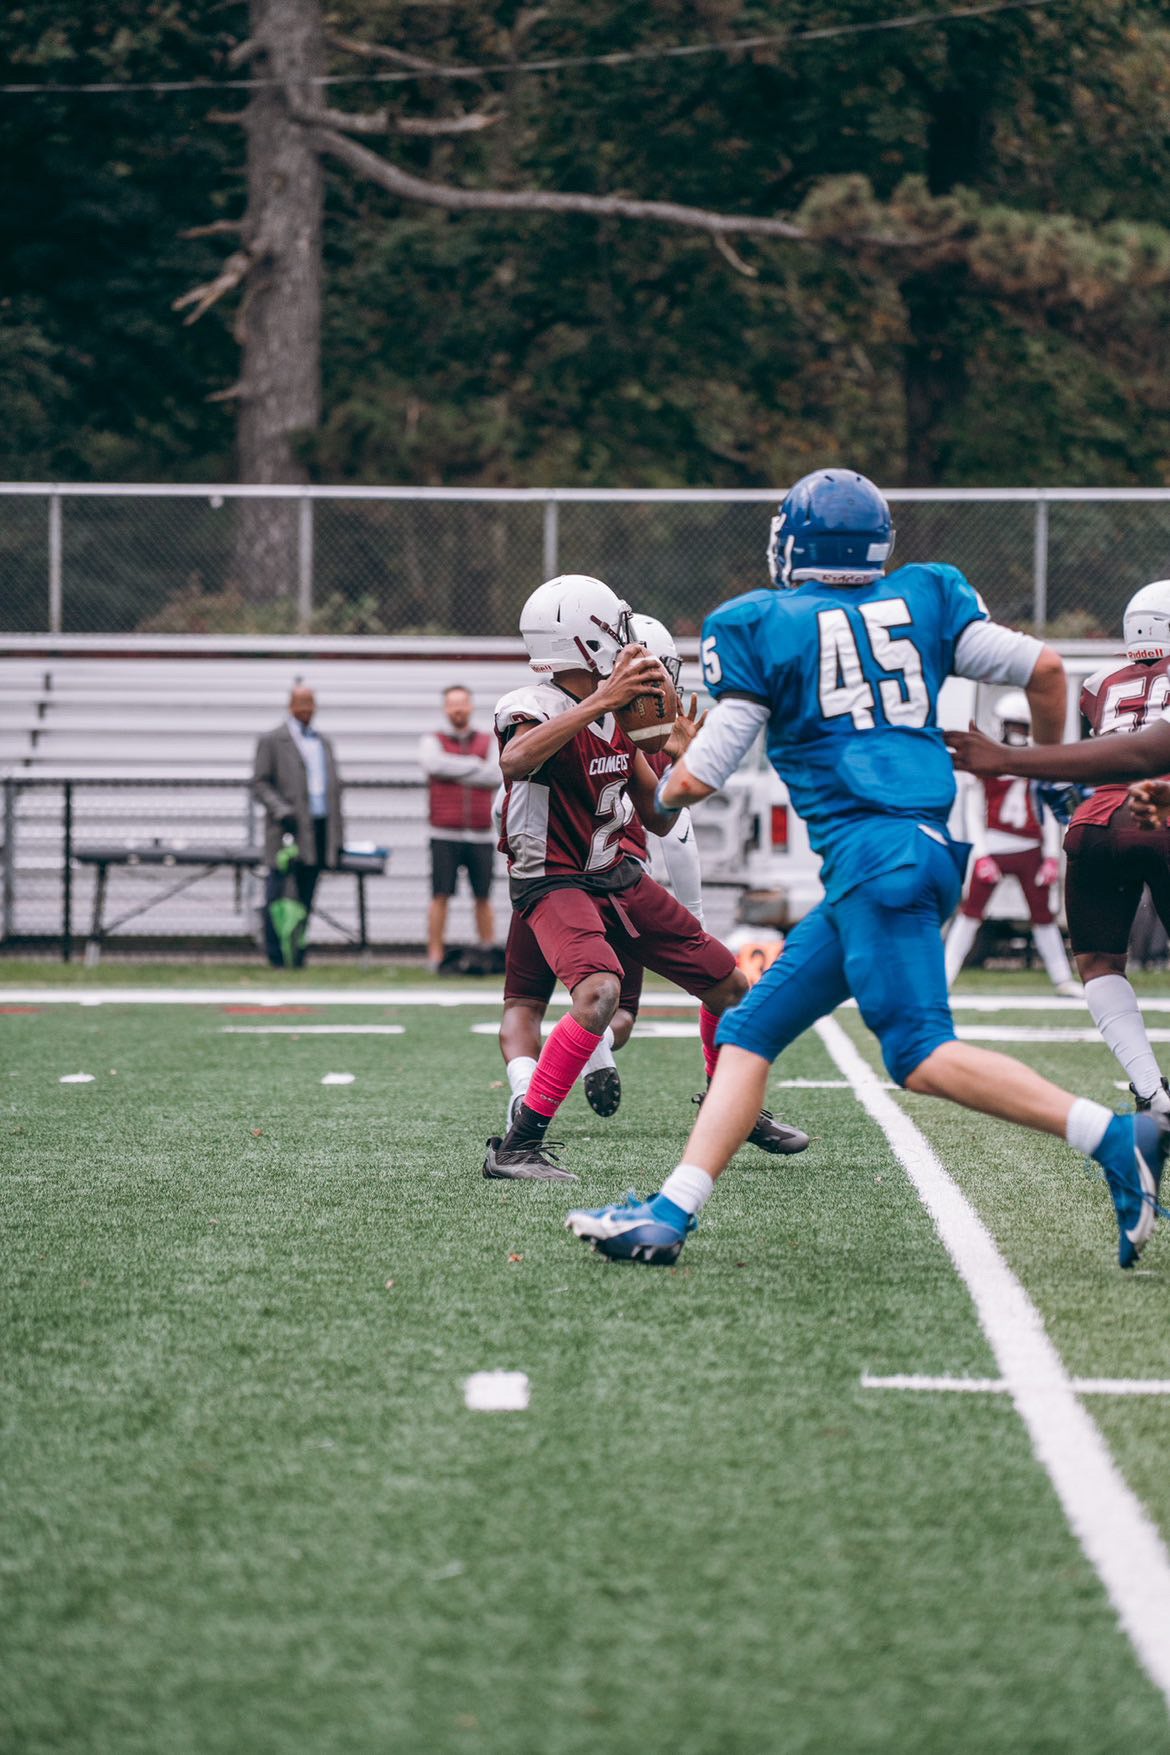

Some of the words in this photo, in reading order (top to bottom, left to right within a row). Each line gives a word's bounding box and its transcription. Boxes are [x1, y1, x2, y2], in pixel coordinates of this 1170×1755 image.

[702, 635, 722, 685] 5
[817, 598, 929, 731] 45
[1127, 648, 1163, 659] Riddell
[584, 778, 628, 872] 2
[999, 779, 1028, 829] 4
